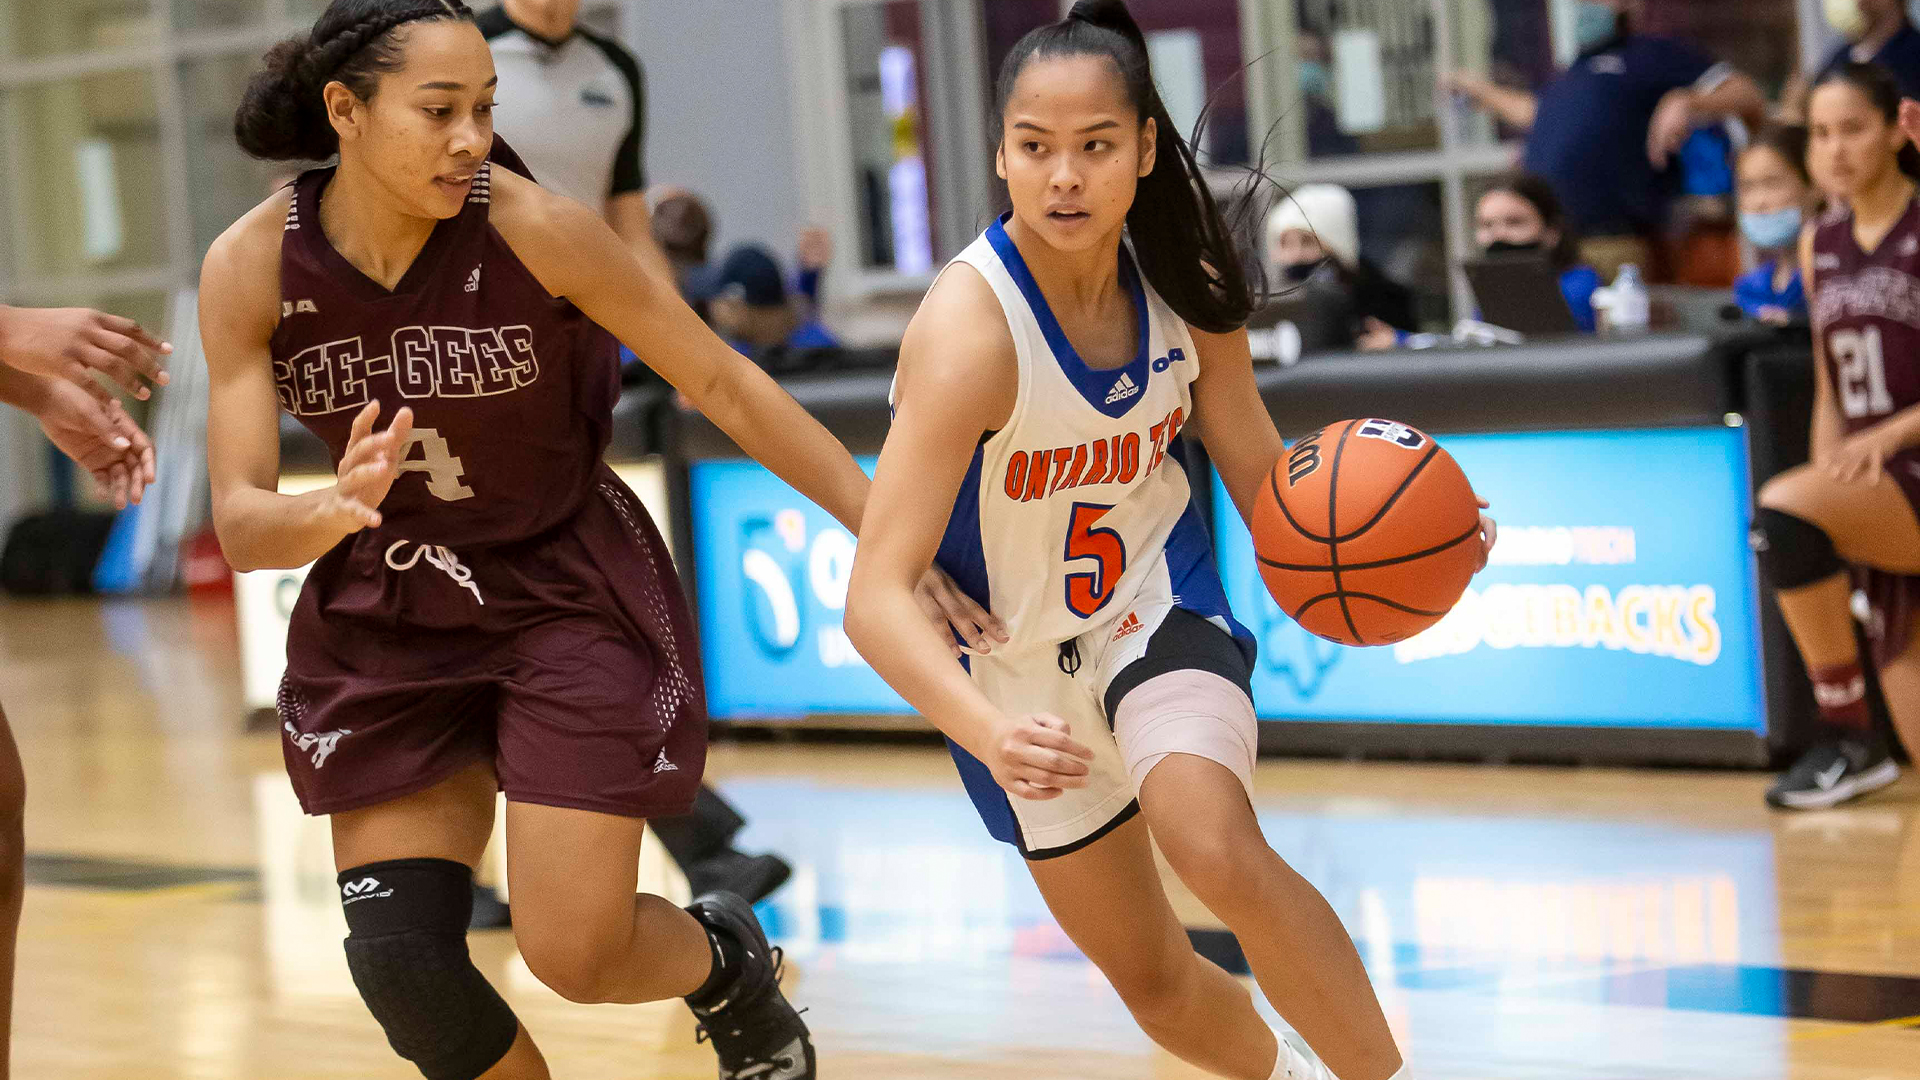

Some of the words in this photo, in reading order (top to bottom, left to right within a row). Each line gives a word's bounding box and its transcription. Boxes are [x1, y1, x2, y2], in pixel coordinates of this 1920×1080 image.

[1105, 385, 1140, 405] adidas
[1828, 325, 1894, 418] 21
[1004, 431, 1141, 503] ONTARIO
[1145, 406, 1185, 478] TEC
[1063, 501, 1127, 619] 5
[1112, 623, 1145, 642] adidas
